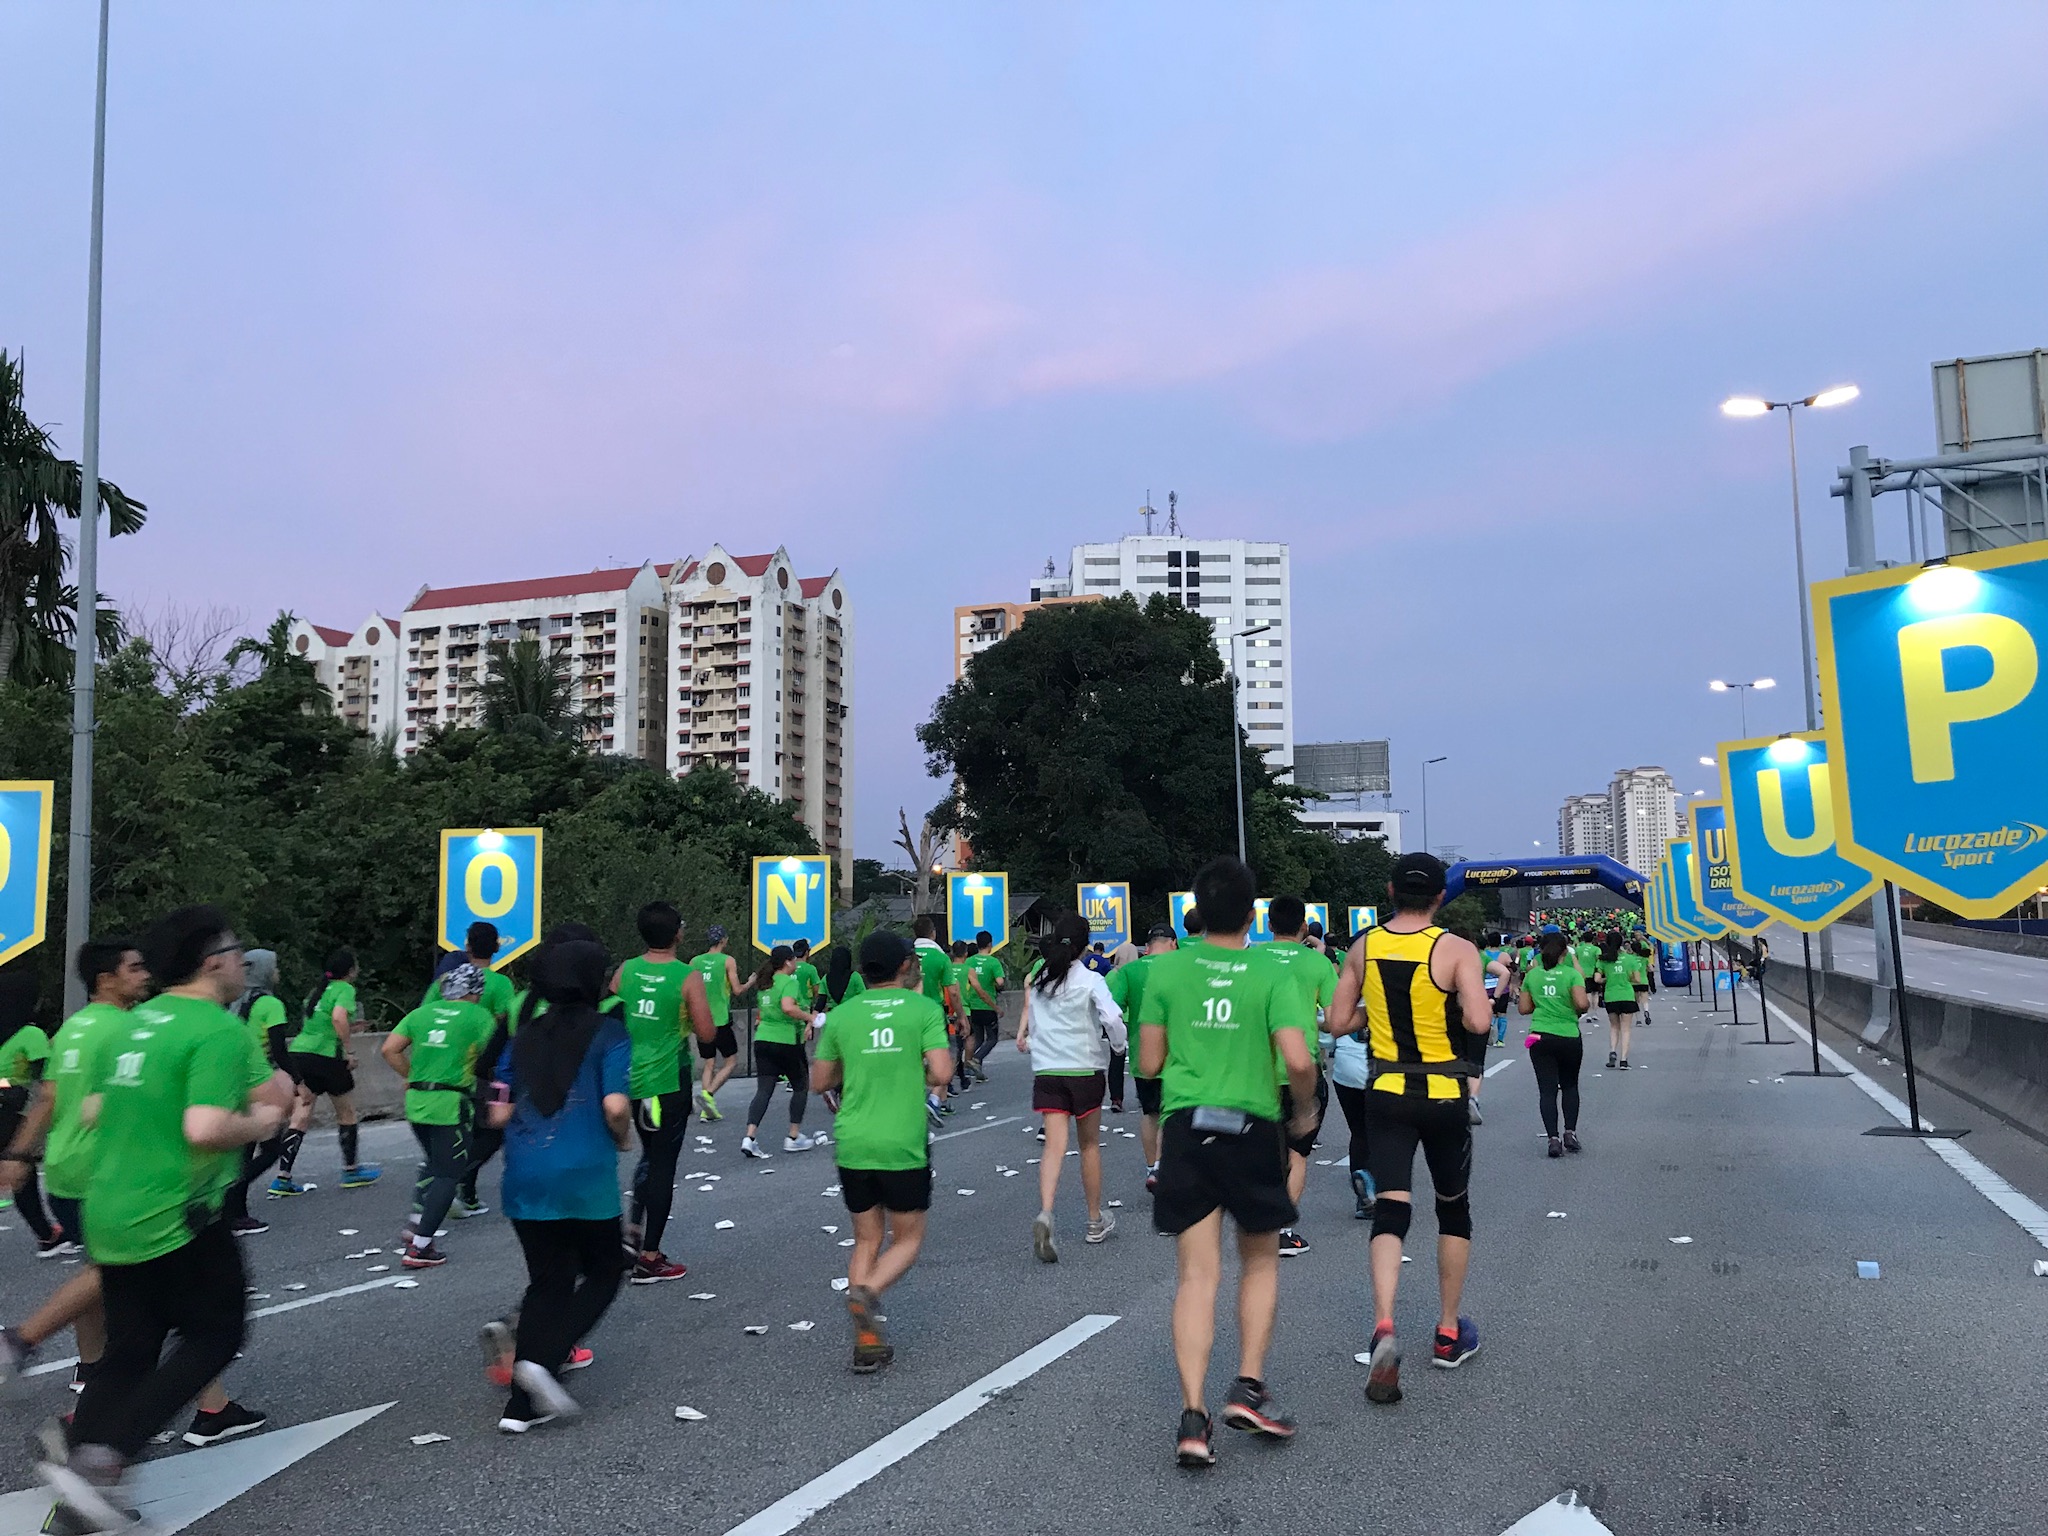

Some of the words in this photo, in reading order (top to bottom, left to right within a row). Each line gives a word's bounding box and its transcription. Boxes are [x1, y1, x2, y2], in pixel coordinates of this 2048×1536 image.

[1898, 613, 2038, 784] P
[1757, 763, 1836, 857] U
[1705, 828, 1728, 864] U
[1904, 826, 2023, 853] Lucozade
[1941, 851, 1996, 870] Sport
[465, 851, 518, 918] O
[1465, 869, 1509, 879] Lucozade
[1770, 882, 1833, 897] Lucozade
[1791, 894, 1818, 905] Sport
[964, 886, 993, 927] T
[1542, 985, 1556, 996] 10
[637, 999, 655, 1015] 10
[1202, 997, 1232, 1022] 10
[869, 1027, 894, 1048] 10
